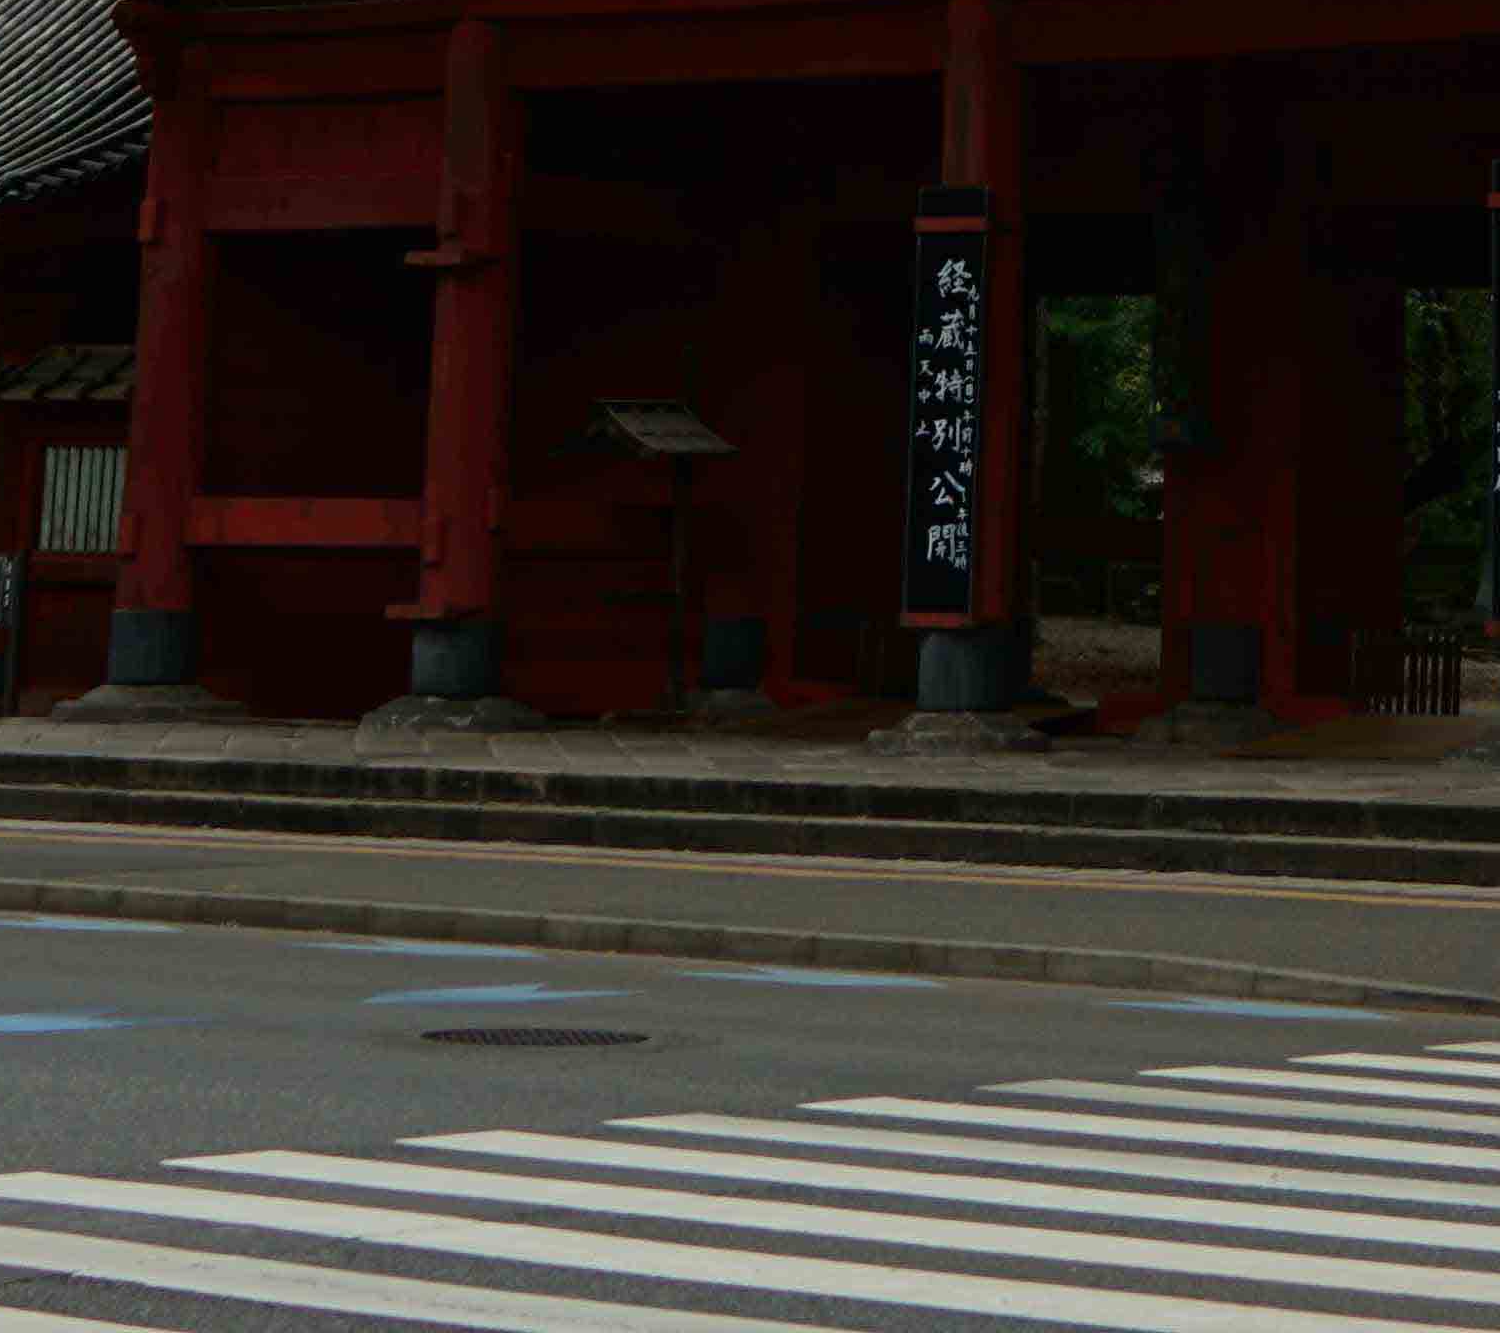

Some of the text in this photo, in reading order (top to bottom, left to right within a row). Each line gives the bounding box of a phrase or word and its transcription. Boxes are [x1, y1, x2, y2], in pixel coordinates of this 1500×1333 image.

[926, 258, 973, 563] 経蔵特別公開
